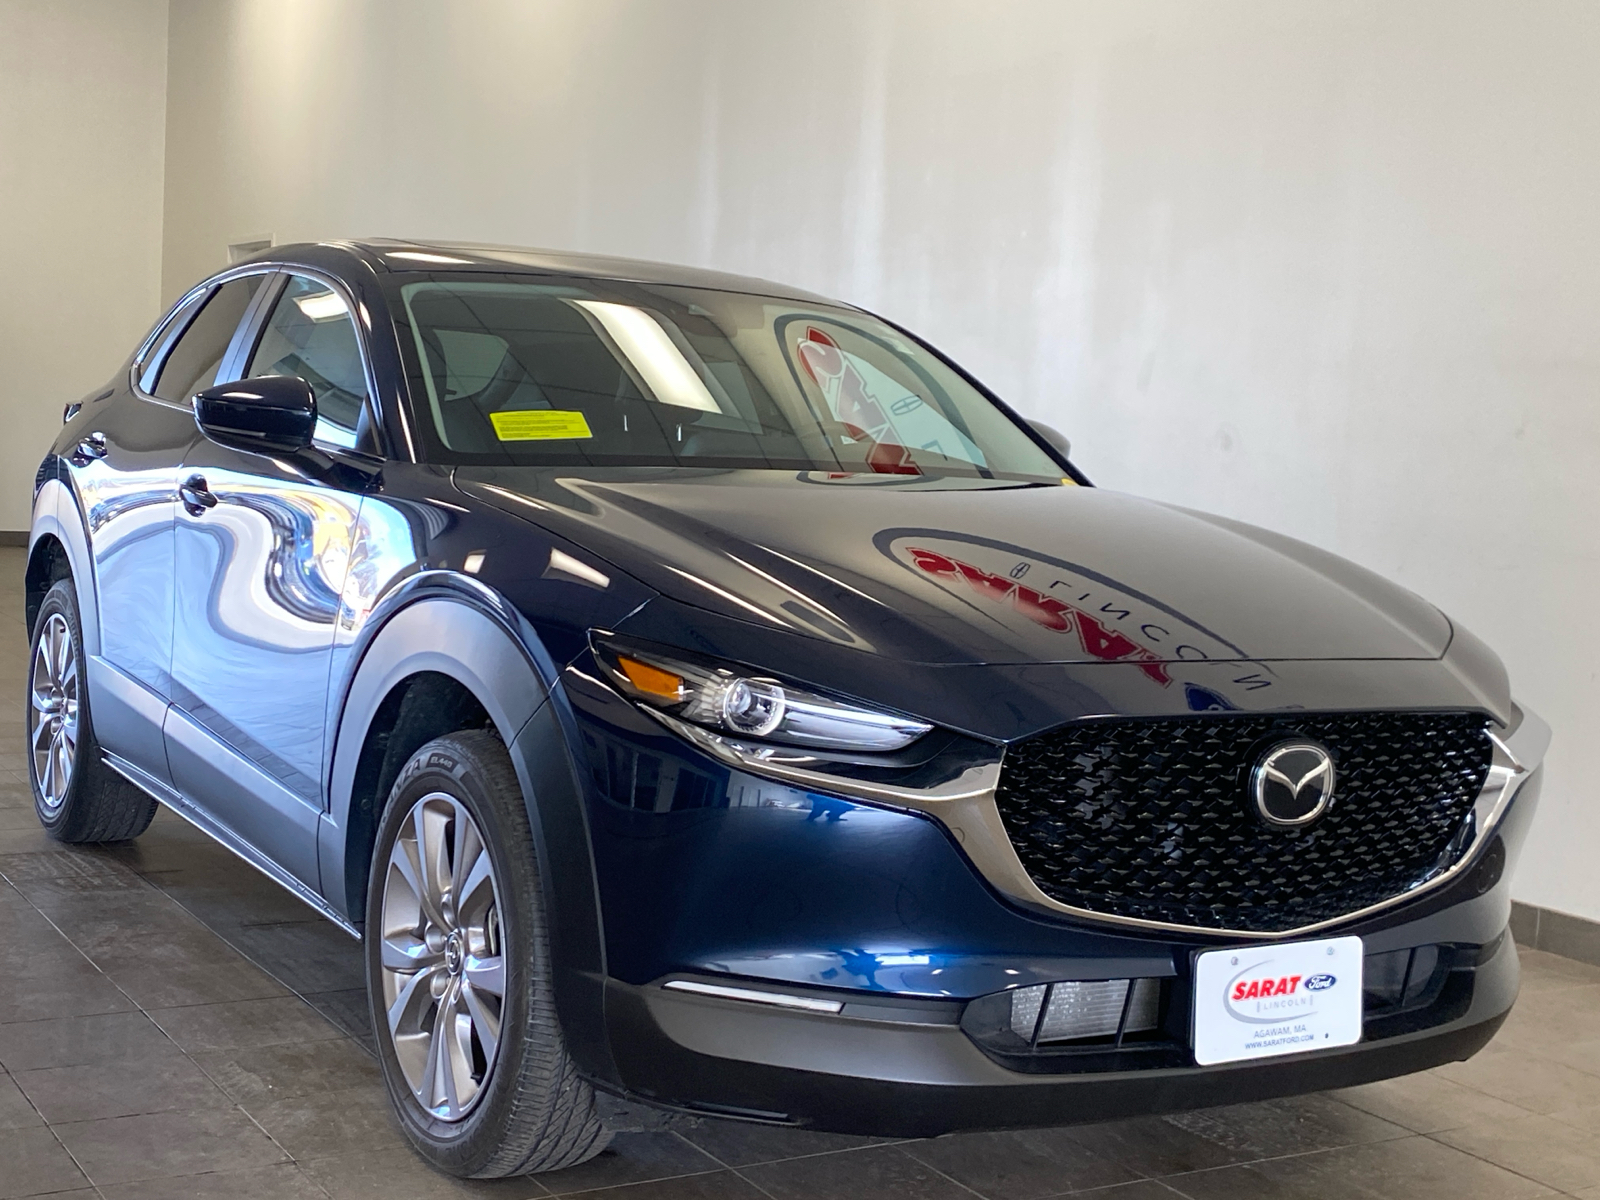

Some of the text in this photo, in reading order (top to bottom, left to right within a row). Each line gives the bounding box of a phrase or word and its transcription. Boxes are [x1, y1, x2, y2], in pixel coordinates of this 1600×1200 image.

[1231, 975, 1302, 1001] SARAT
[1264, 998, 1307, 1010] LINCOLN
[1253, 1024, 1307, 1039] AGAWAM, MA
[1245, 1034, 1315, 1050] WWW.SARATFORD.COM
